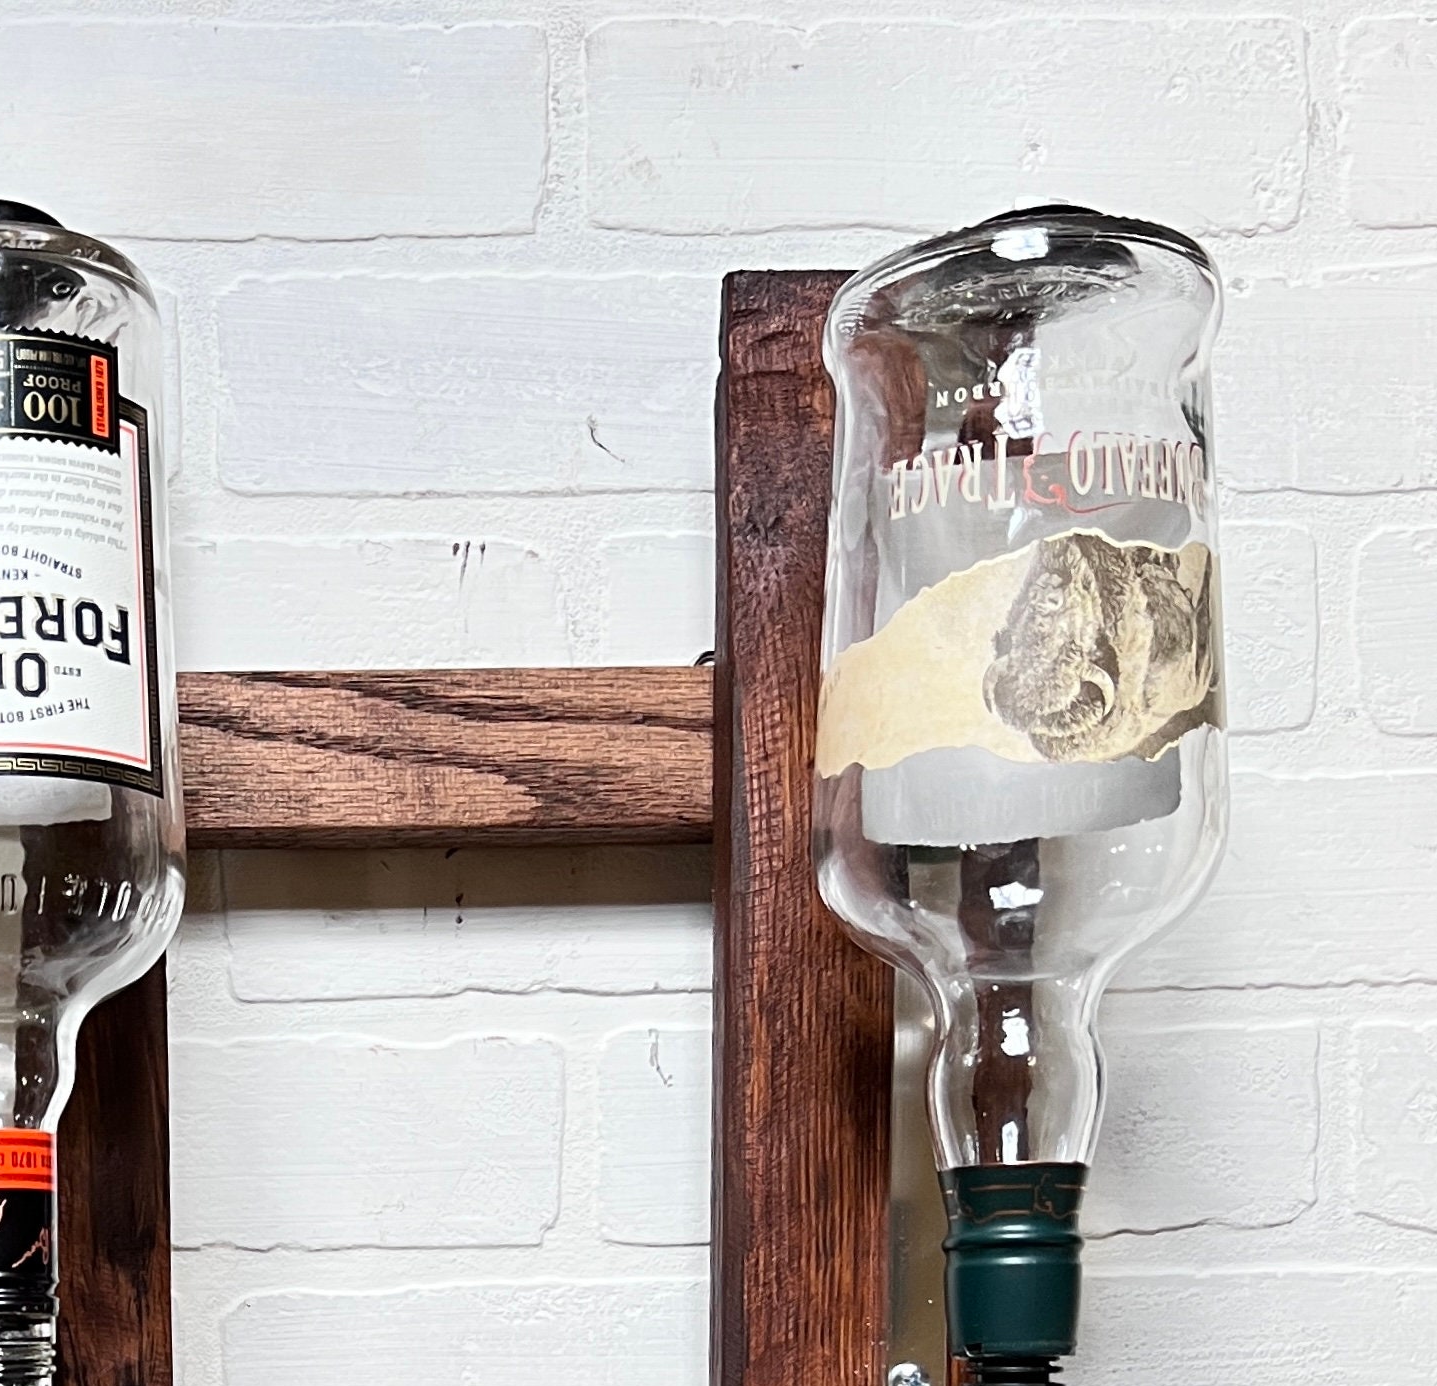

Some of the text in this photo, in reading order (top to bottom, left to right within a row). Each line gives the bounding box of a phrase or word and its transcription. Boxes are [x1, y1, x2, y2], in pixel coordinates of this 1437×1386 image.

[22, 373, 82, 393] PROOF
[23, 390, 82, 427] 100
[887, 431, 1205, 520] BUFFALO TRACE
[21, 548, 83, 579] STRAIGHT
[53, 665, 81, 677] ESTD
[29, 702, 64, 721] FIRST
[67, 697, 90, 712] THE
[11, 1152, 37, 1169] 1870
